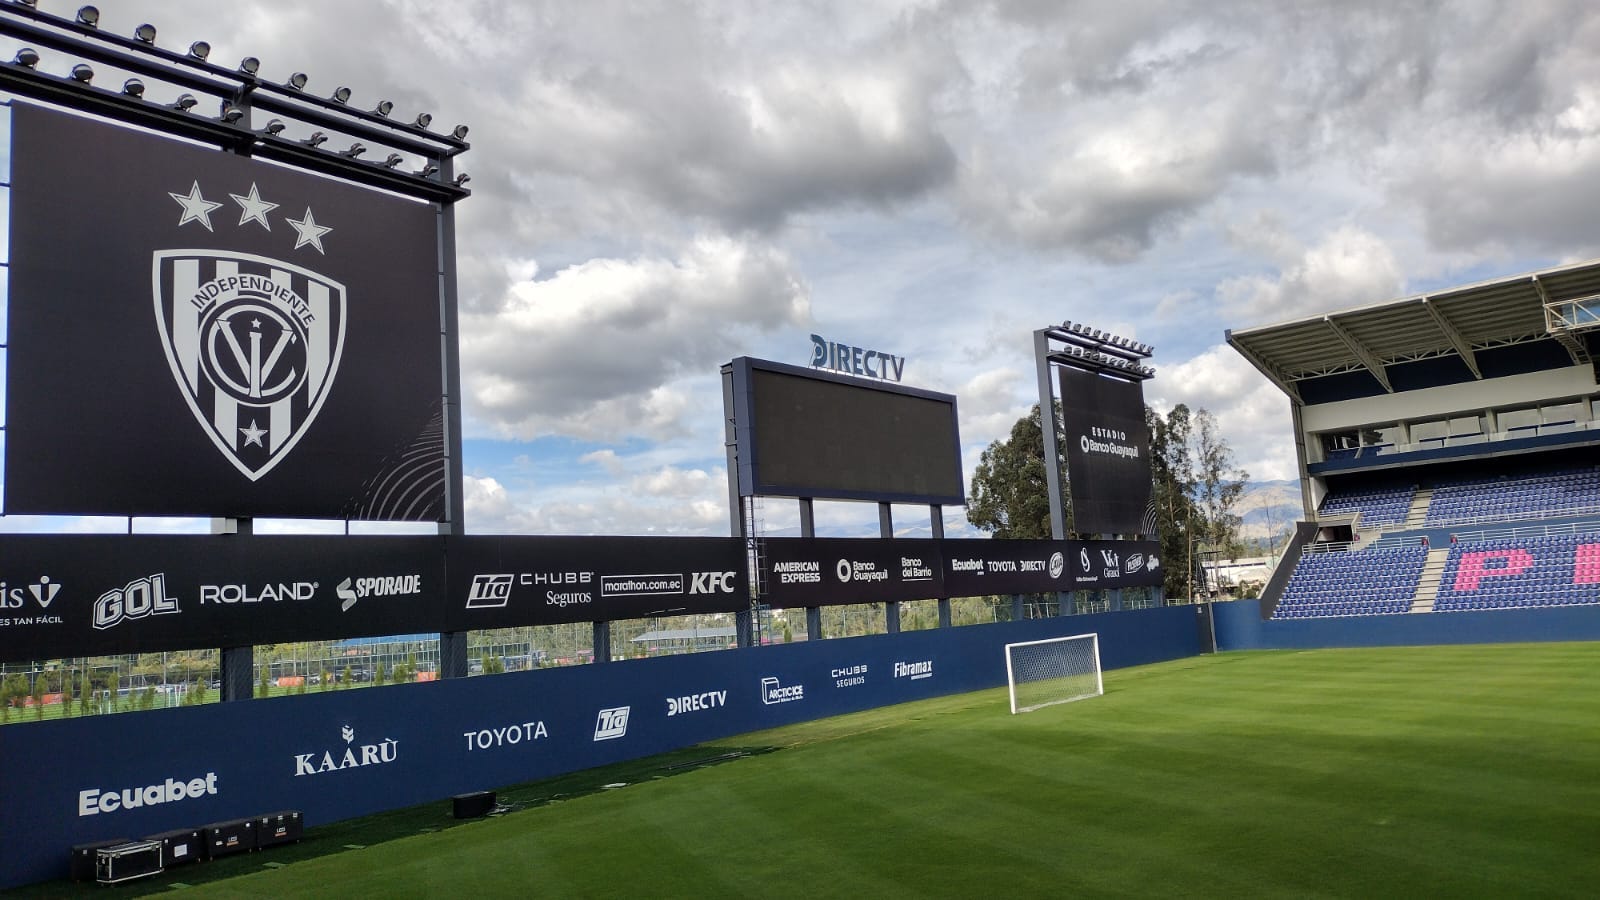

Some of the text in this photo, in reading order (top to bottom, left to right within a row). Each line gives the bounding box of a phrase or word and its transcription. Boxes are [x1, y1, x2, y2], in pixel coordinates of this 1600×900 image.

[190, 275, 317, 329] INDEPENDIENTE
[810, 333, 905, 382] DIRECTV
[1091, 426, 1126, 441] ESTADIO
[1089, 439, 1139, 459] Banco Guayaquil
[773, 561, 819, 573] AMERICAN
[853, 561, 875, 571] Banco
[901, 557, 922, 567] Banco
[987, 561, 1017, 572] TOYOTA
[1020, 560, 1046, 572] DIRECTV
[781, 572, 821, 584] EXPRESS
[853, 568, 889, 583] Guayaquil
[902, 566, 932, 578] del Barrio
[355, 574, 421, 598] SPORADE
[604, 580, 681, 592] marathon.com.ec
[689, 571, 737, 595] KFC
[92, 573, 182, 630] GOL
[546, 590, 592, 607] Seguros
[13, 617, 33, 625] TAN
[36, 614, 64, 624] FÁCIL
[831, 664, 868, 678] CHUBB
[894, 660, 933, 678] Fibramax
[836, 676, 865, 688] SEGUROS
[666, 690, 727, 717] DIRECTV
[463, 720, 549, 751] TOYOTA
[78, 772, 218, 817] Ecuabet
